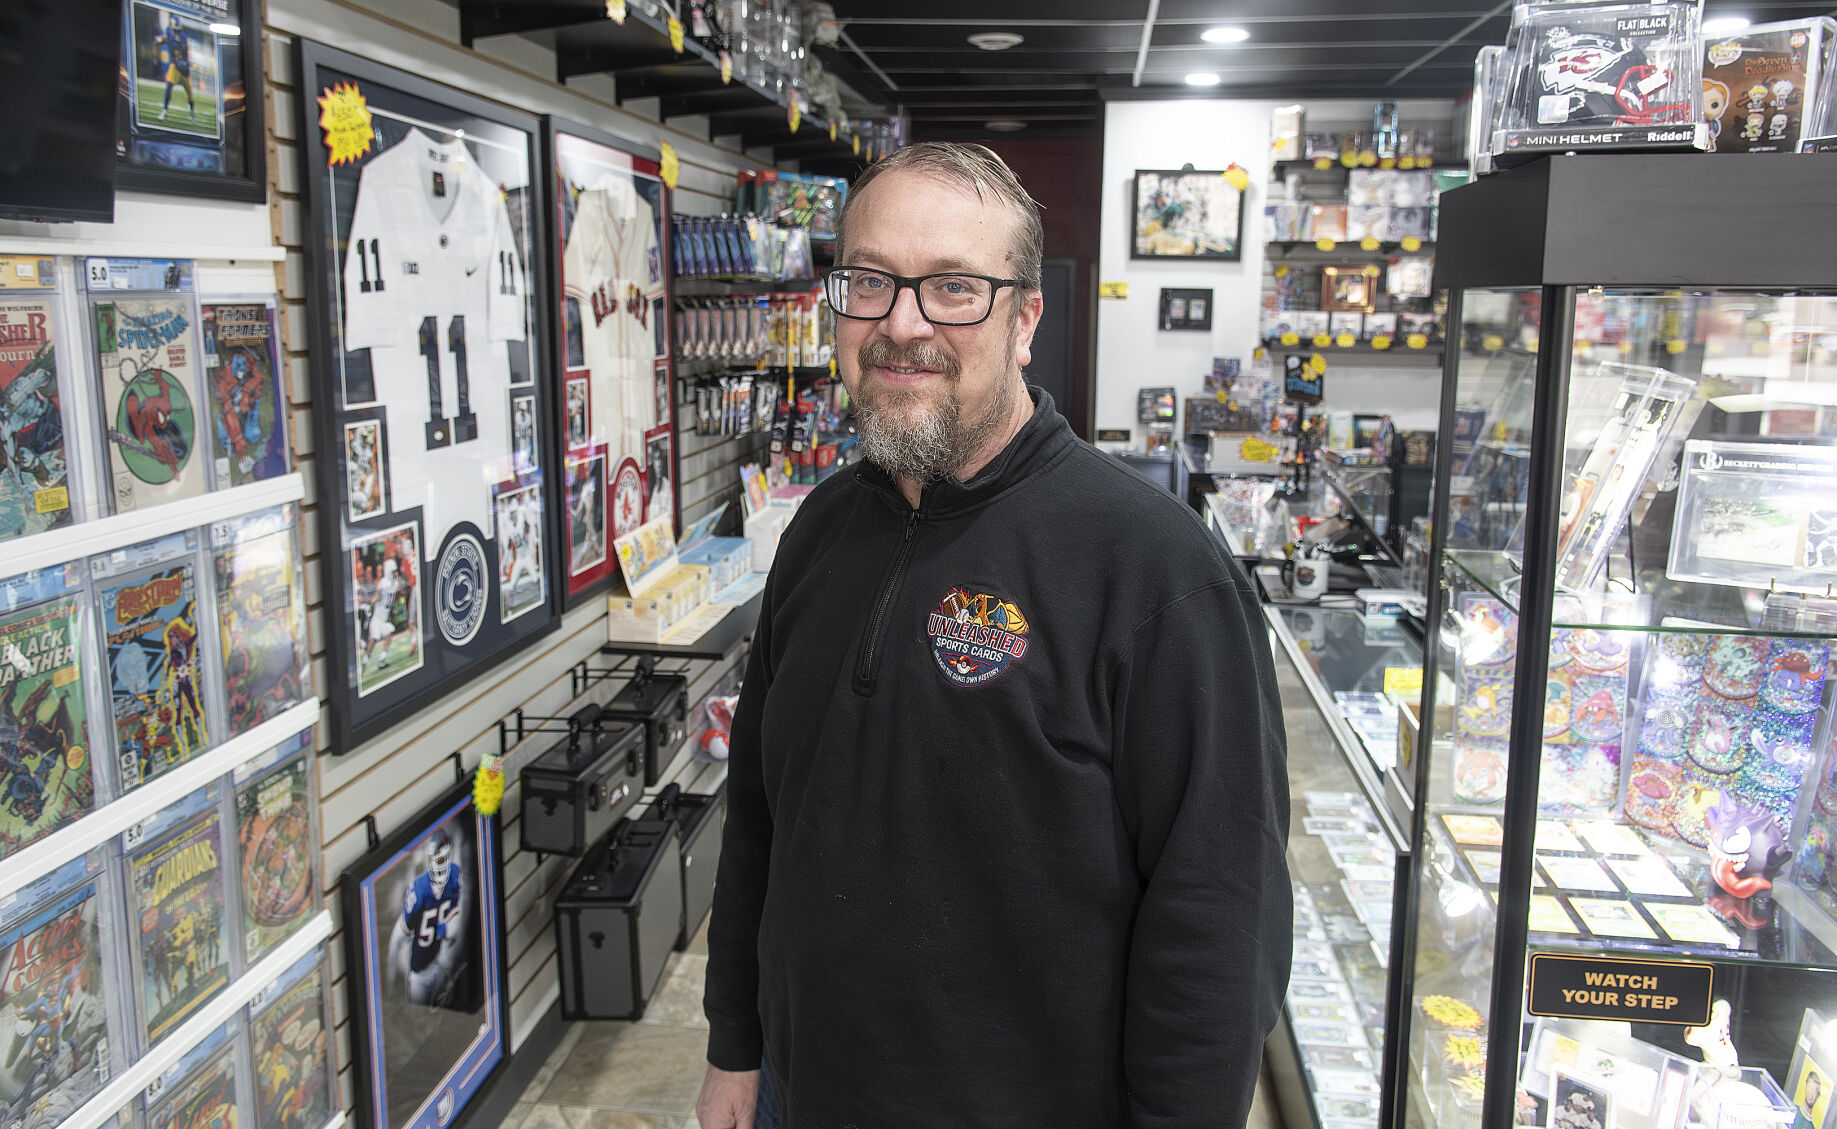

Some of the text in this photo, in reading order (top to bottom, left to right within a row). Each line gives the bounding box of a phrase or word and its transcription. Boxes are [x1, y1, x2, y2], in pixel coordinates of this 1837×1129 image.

[1617, 17, 1667, 31] FLAT BLACK
[1526, 133, 1623, 145] MINI HELMET
[1647, 131, 1692, 142] Riddell
[91, 265, 108, 281] 5.0
[357, 238, 385, 293] 11
[499, 250, 517, 296] 11
[117, 313, 190, 350] SPIDER-MAN
[418, 315, 478, 451] 11
[928, 614, 1027, 658] UNLEASHED
[935, 636, 1004, 663] SPORTS CARDS
[0, 644, 76, 688] ATHER
[1584, 971, 1659, 990] WATCH
[1561, 988, 1679, 1011] YOUR STEP
